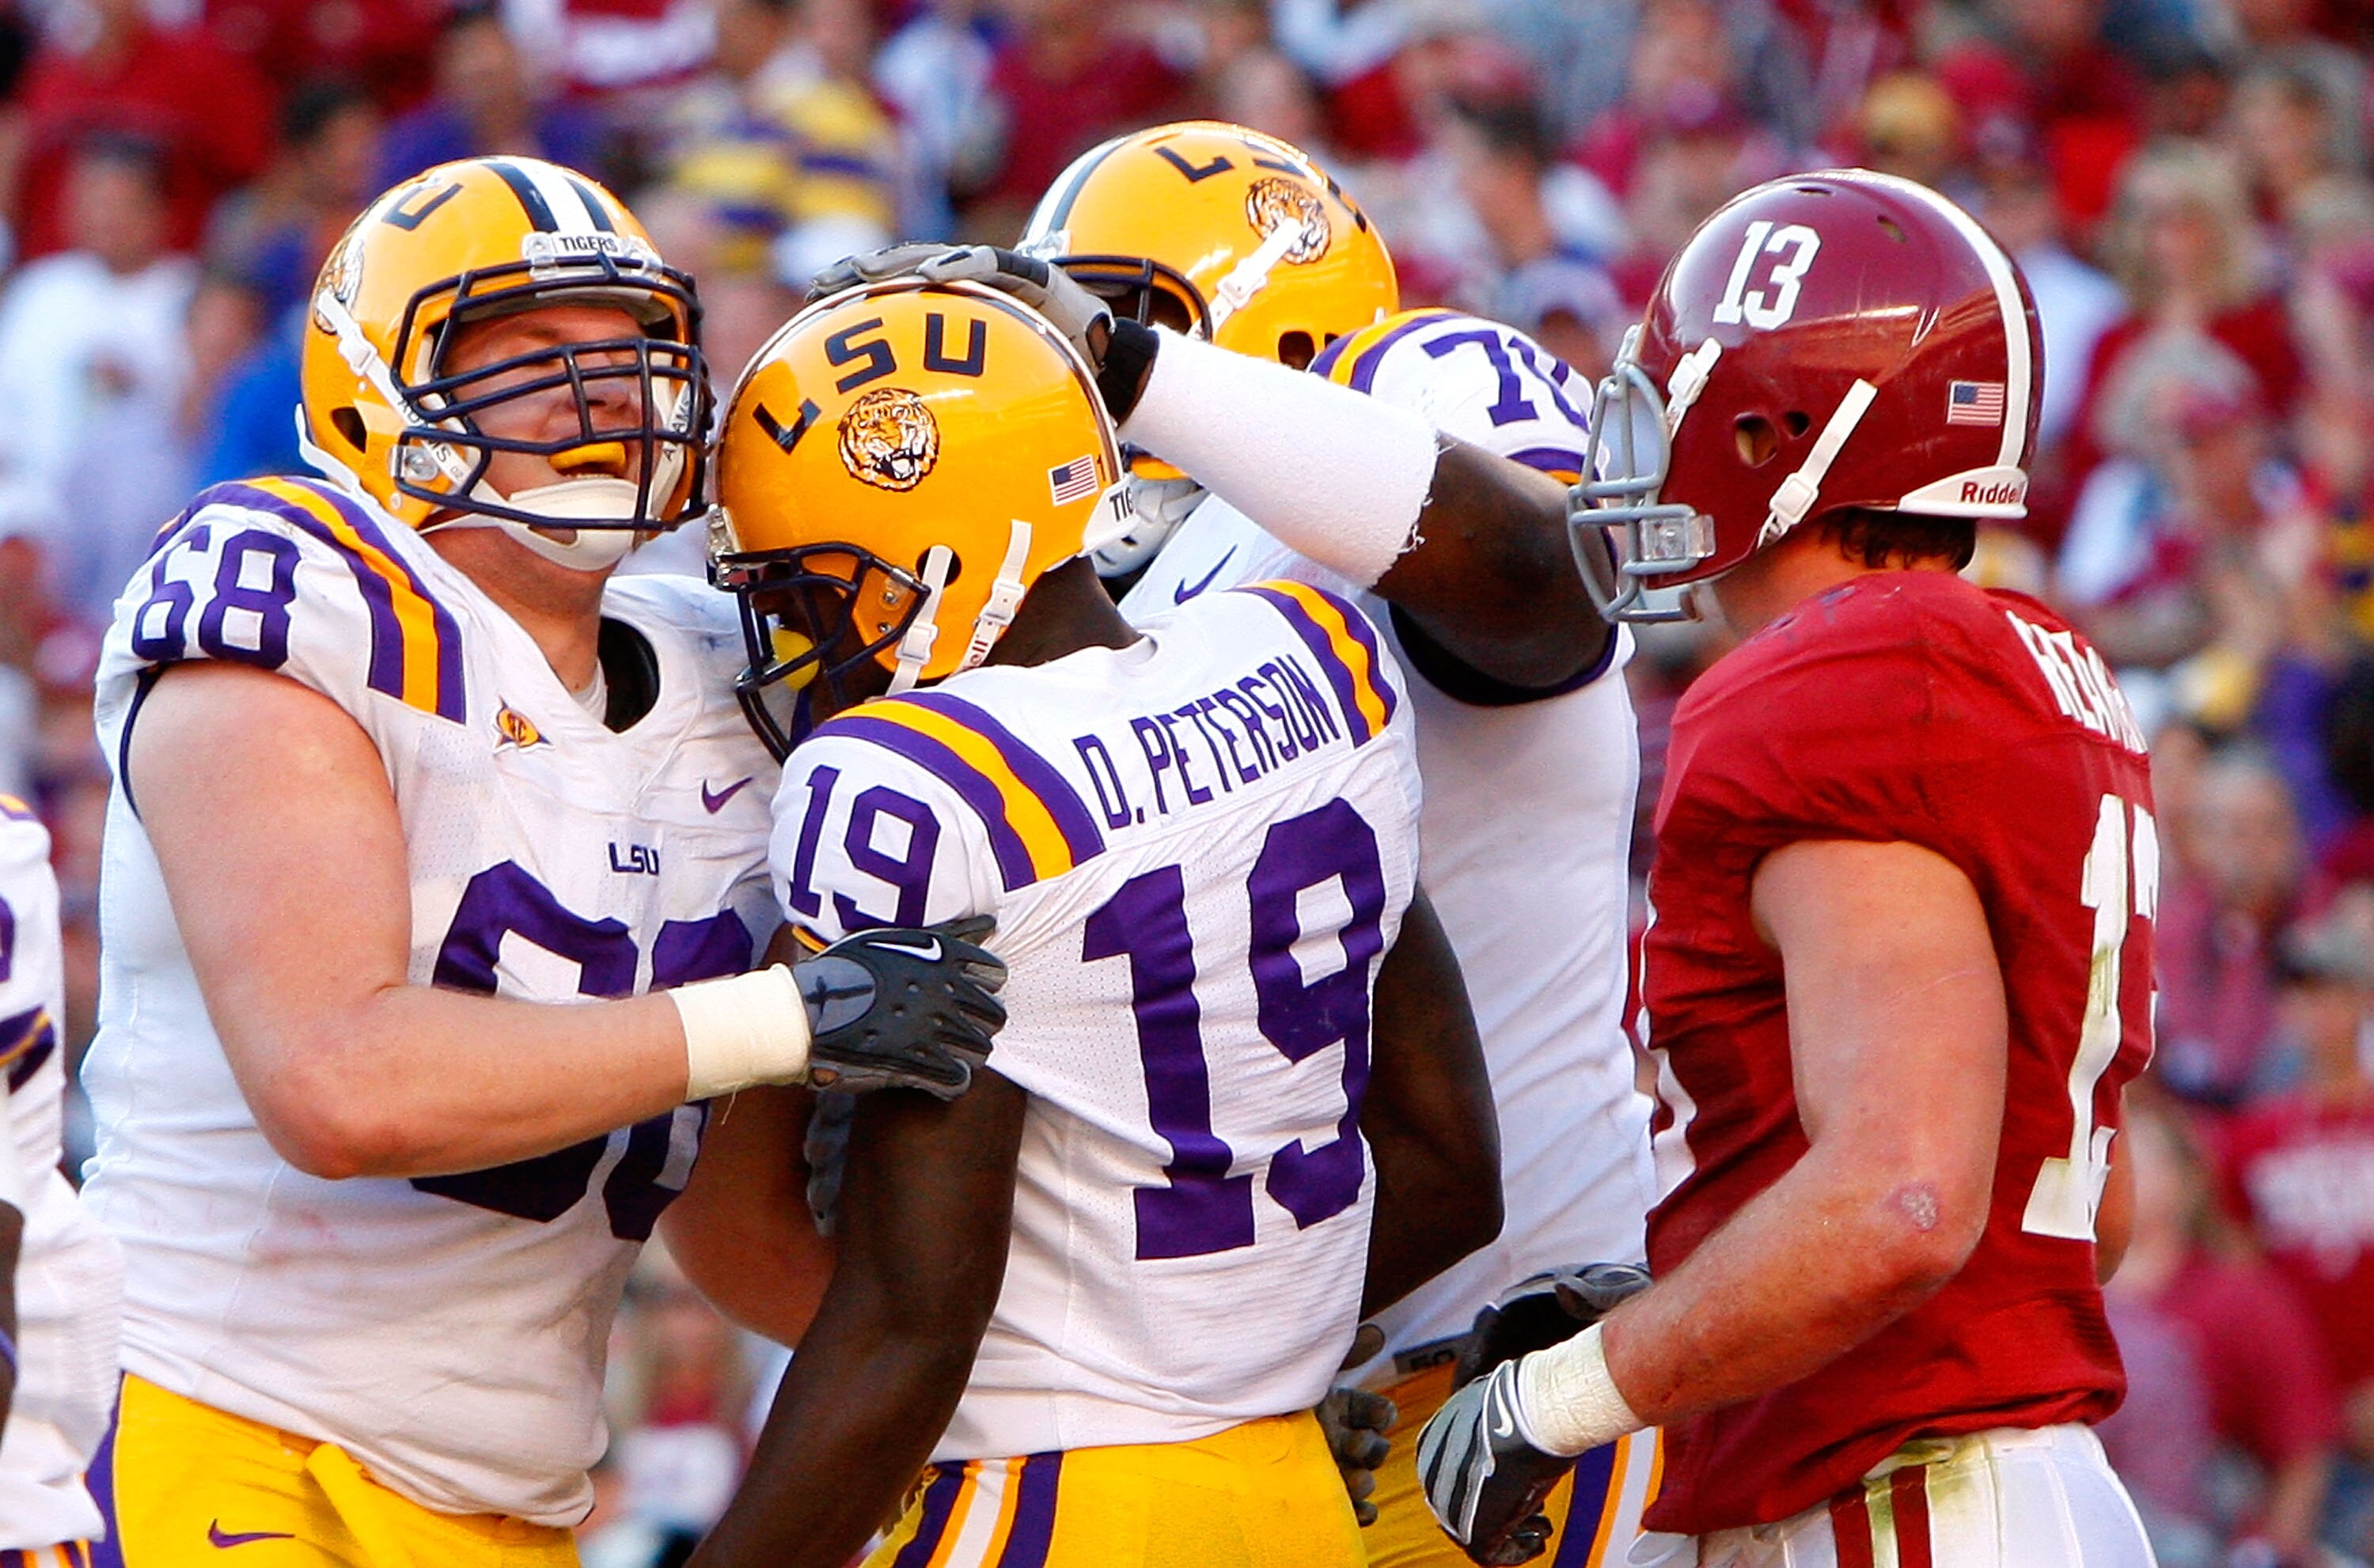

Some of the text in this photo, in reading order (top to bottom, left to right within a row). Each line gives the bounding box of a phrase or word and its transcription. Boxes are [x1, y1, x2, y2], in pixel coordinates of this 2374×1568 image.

[559, 235, 618, 253] TIGERS
[1712, 219, 1823, 331] 13
[753, 312, 987, 456] LSU
[1960, 481, 2023, 504] Ridde
[131, 524, 303, 670] 68
[1071, 653, 1341, 830] D. PETERSON
[609, 843, 660, 876] LSU
[789, 764, 942, 931] 19
[1082, 797, 1386, 1260] 19
